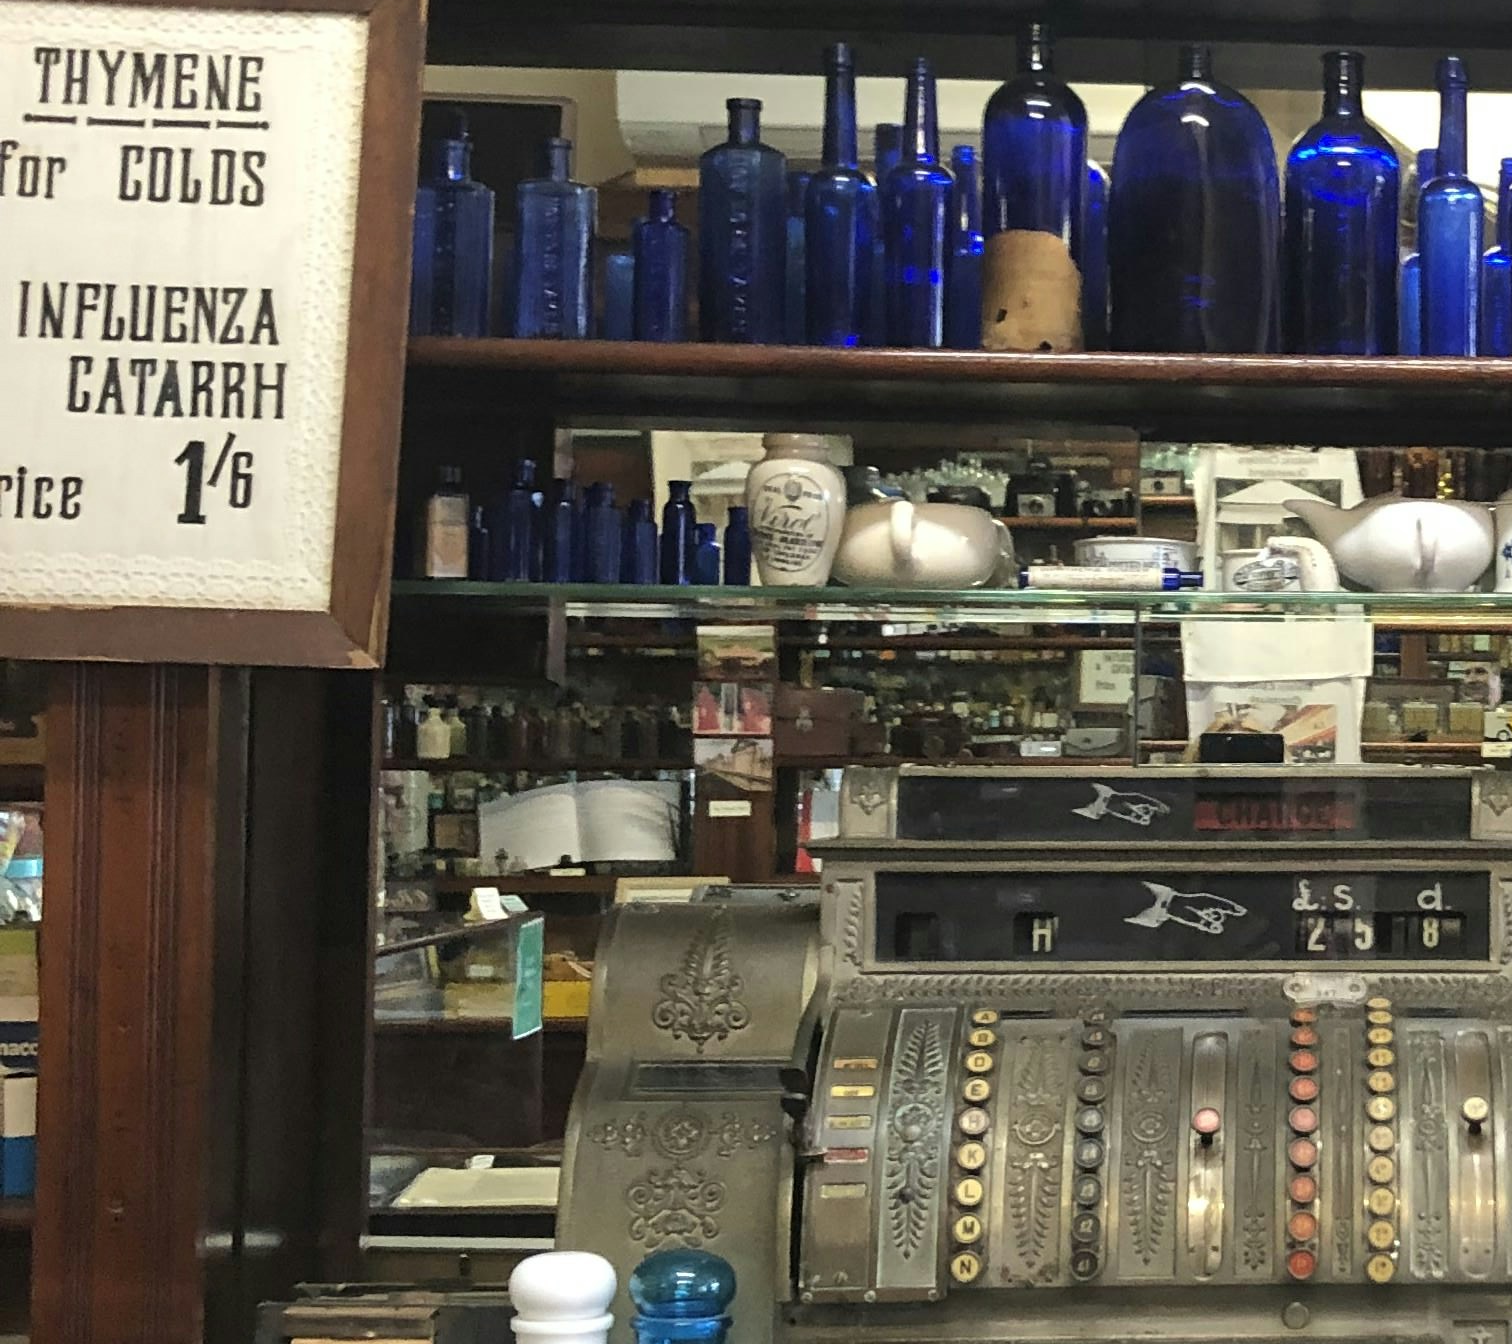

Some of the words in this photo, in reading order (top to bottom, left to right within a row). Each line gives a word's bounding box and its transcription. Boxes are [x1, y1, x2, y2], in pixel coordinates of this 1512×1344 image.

[34, 46, 264, 112] THYMENE
[0, 140, 66, 199] for
[119, 145, 266, 207] COLDS
[18, 280, 280, 346] INFLUENZA
[67, 355, 287, 420] CATARRH
[0, 465, 83, 520] rice
[174, 432, 253, 525] 1/6
